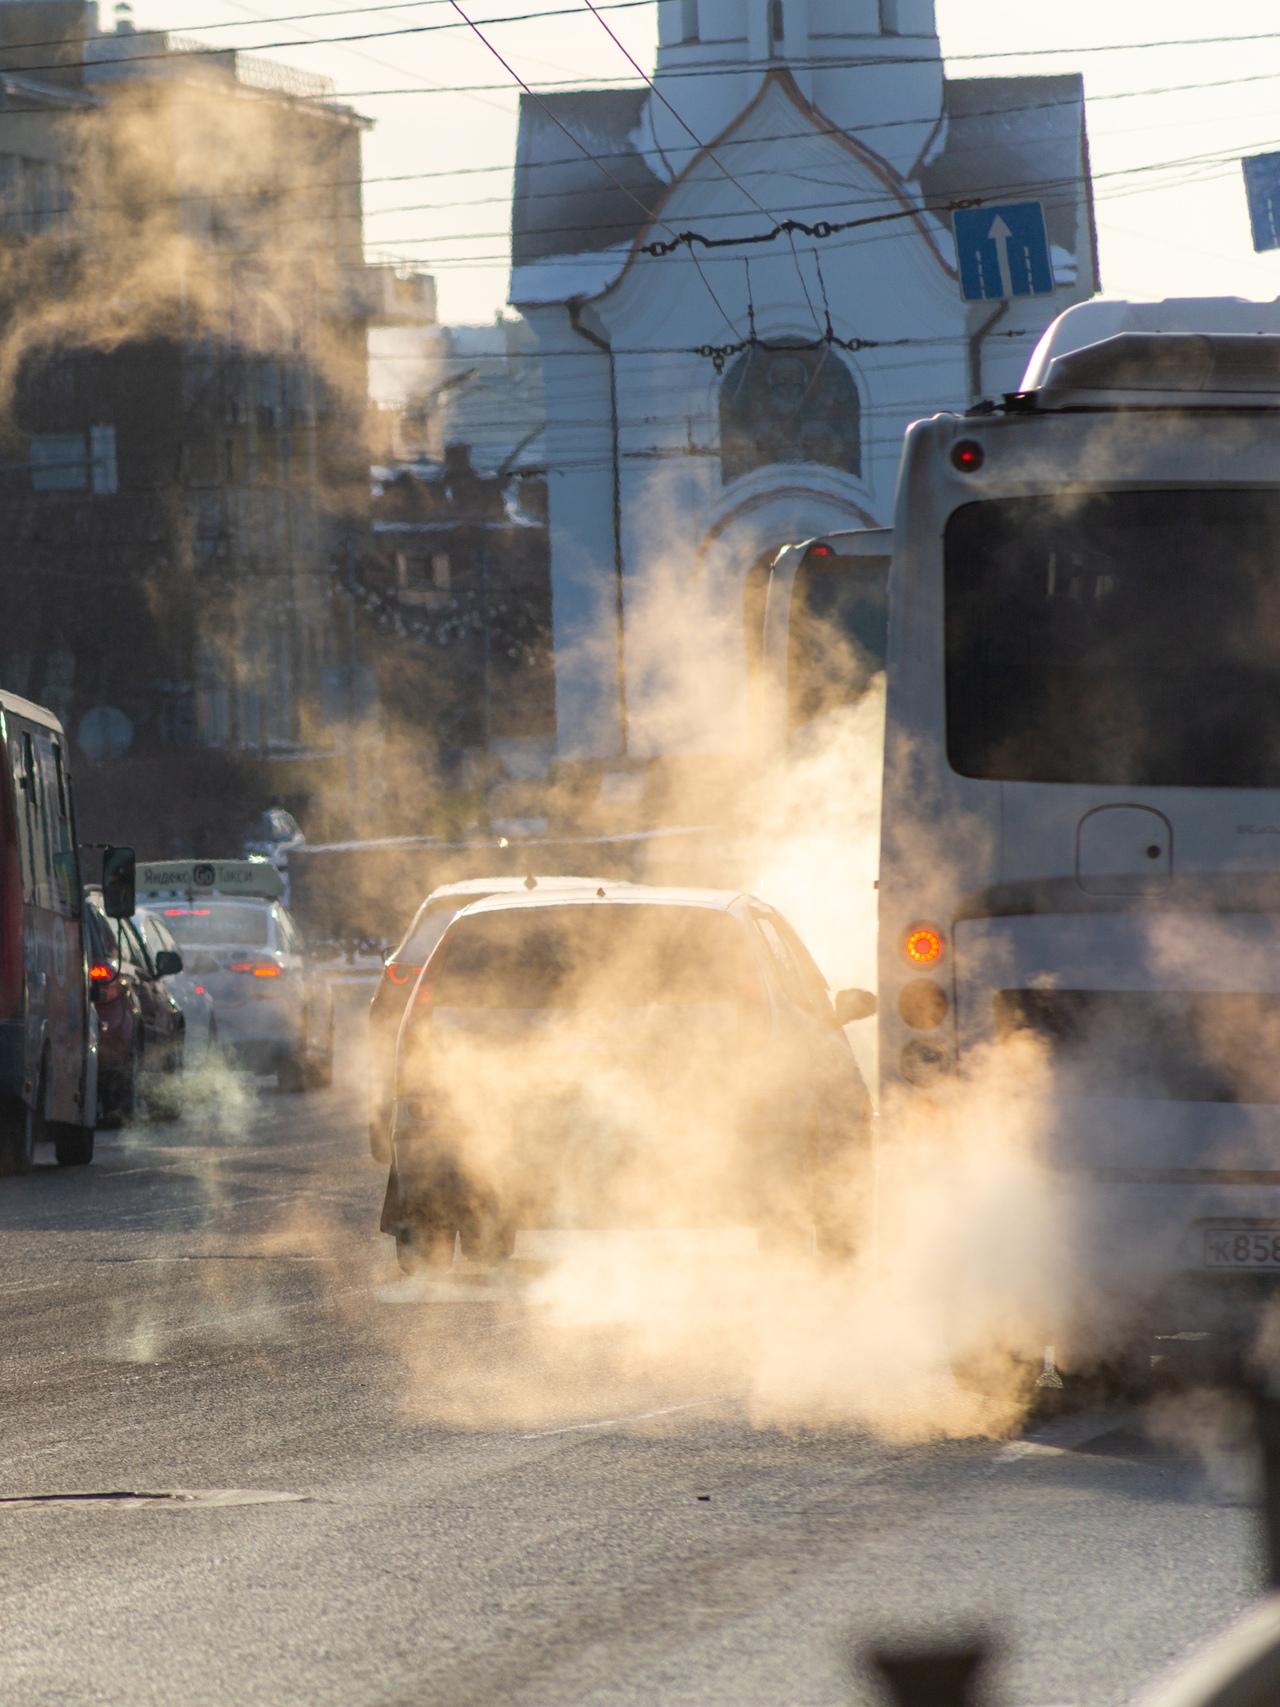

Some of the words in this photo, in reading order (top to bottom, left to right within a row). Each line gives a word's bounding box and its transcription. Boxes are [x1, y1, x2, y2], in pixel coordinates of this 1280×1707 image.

[144, 869, 189, 885] Яндекс
[194, 866, 214, 883] Go
[218, 867, 254, 883] Такси
